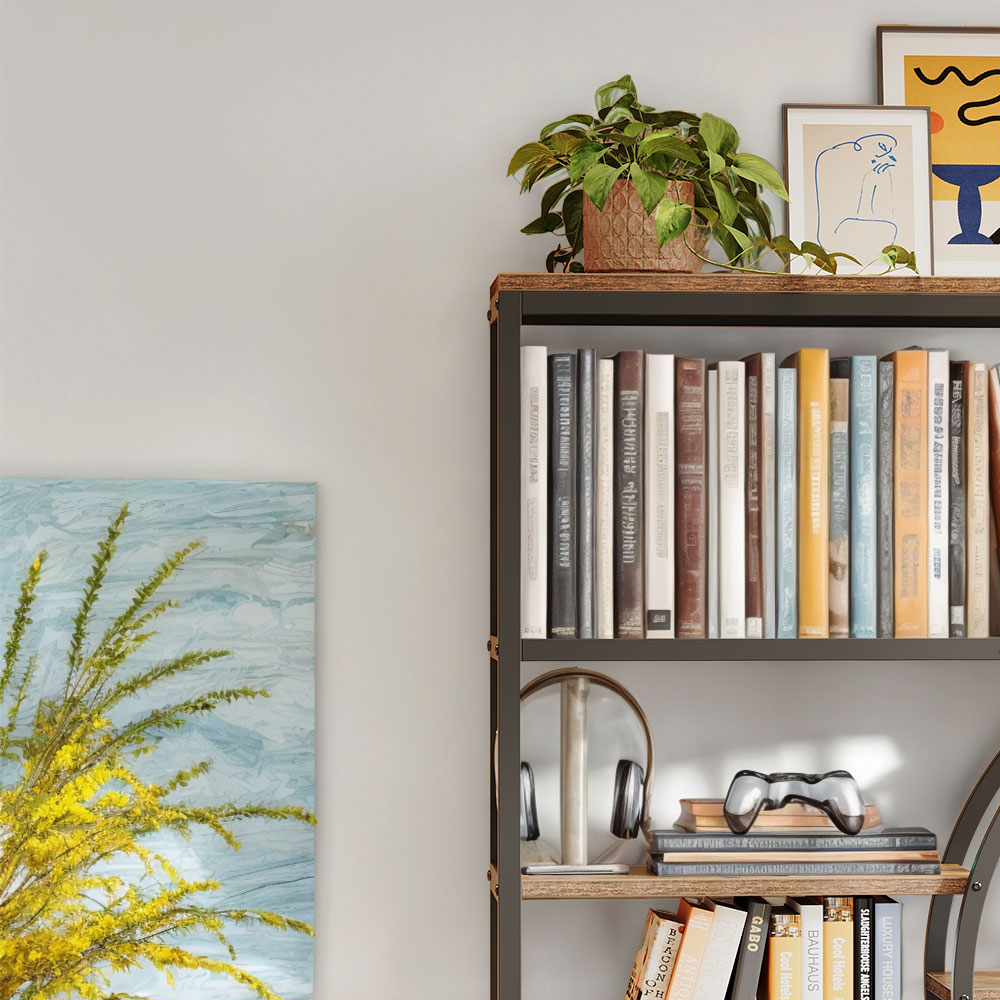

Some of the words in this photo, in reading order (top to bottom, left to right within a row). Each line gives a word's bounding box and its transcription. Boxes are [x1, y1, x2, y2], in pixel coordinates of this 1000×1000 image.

[747, 916, 763, 953] GABO
[832, 937, 846, 959] Cool
[860, 908, 870, 972] SLAUGHTERHOUSE
[882, 916, 893, 958] LUXURY
[655, 928, 677, 982] BEACON
[779, 951, 793, 970] Cool
[807, 929, 819, 992] BAUHAUS
[644, 979, 656, 996] OF
[779, 972, 793, 1000] Hotels
[832, 960, 846, 991] Hotels
[860, 973, 870, 1000] ANGELS
